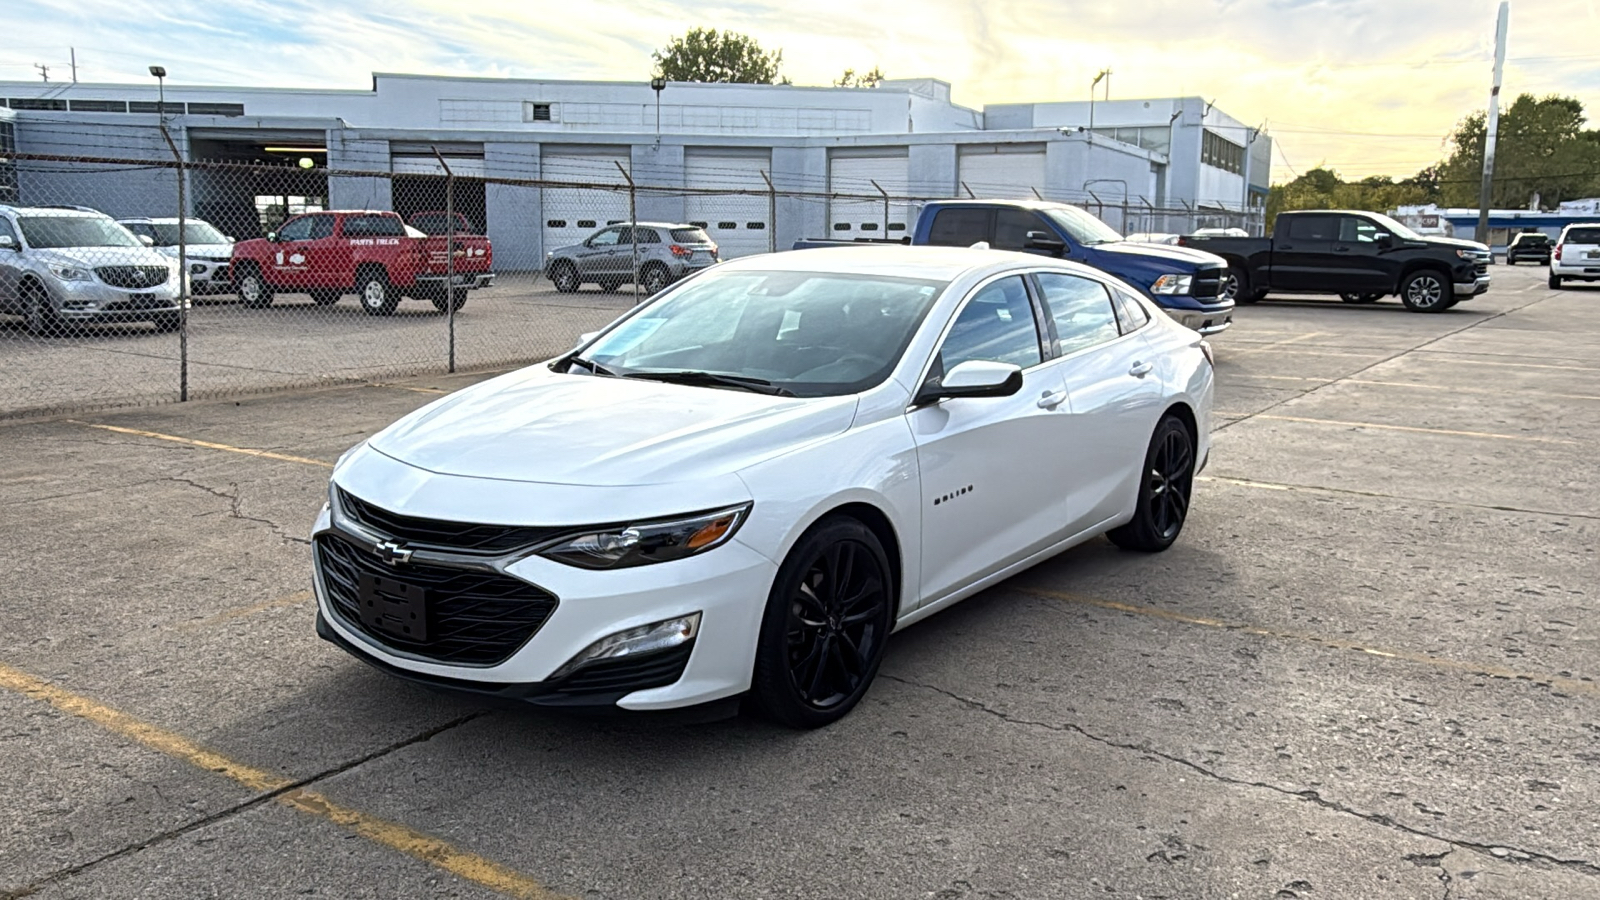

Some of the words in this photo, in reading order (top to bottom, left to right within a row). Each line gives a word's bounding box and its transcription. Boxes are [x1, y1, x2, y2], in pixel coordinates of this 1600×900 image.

[350, 238, 374, 246] PARTS
[376, 238, 399, 246] TRUCK
[934, 484, 973, 506] MALIBU
